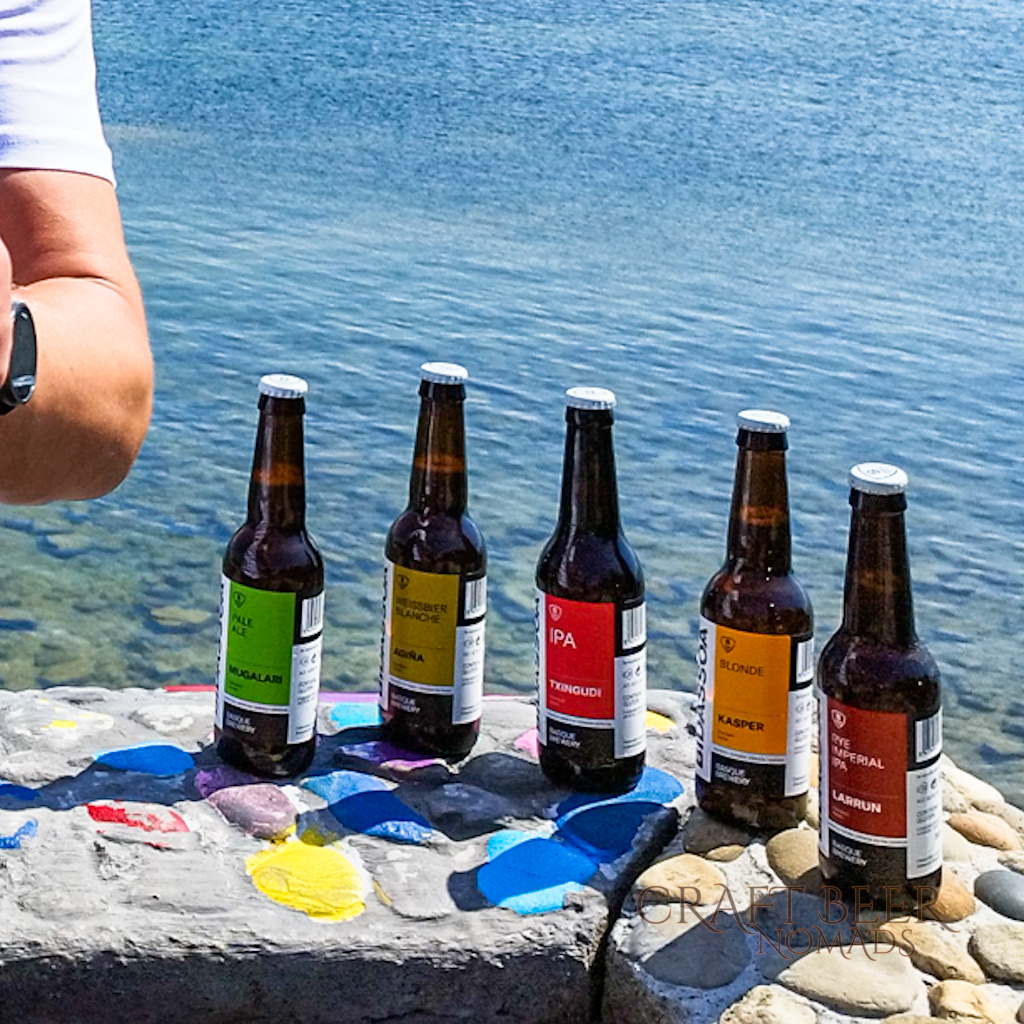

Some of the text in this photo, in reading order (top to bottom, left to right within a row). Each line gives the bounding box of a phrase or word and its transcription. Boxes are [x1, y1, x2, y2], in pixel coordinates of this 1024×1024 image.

[232, 614, 253, 629] PALE
[396, 606, 441, 624] BLANCHE
[232, 626, 247, 637] ALE
[550, 627, 577, 649] IPA
[228, 664, 283, 684] MUGALARI
[719, 659, 765, 677] BLONDE
[549, 679, 602, 697] TXINGUDI
[718, 714, 765, 732] KASPER
[831, 733, 851, 749] RYE
[831, 744, 885, 770] IMPERIAL
[831, 756, 848, 772] IPA
[832, 789, 882, 814] LARRUN
